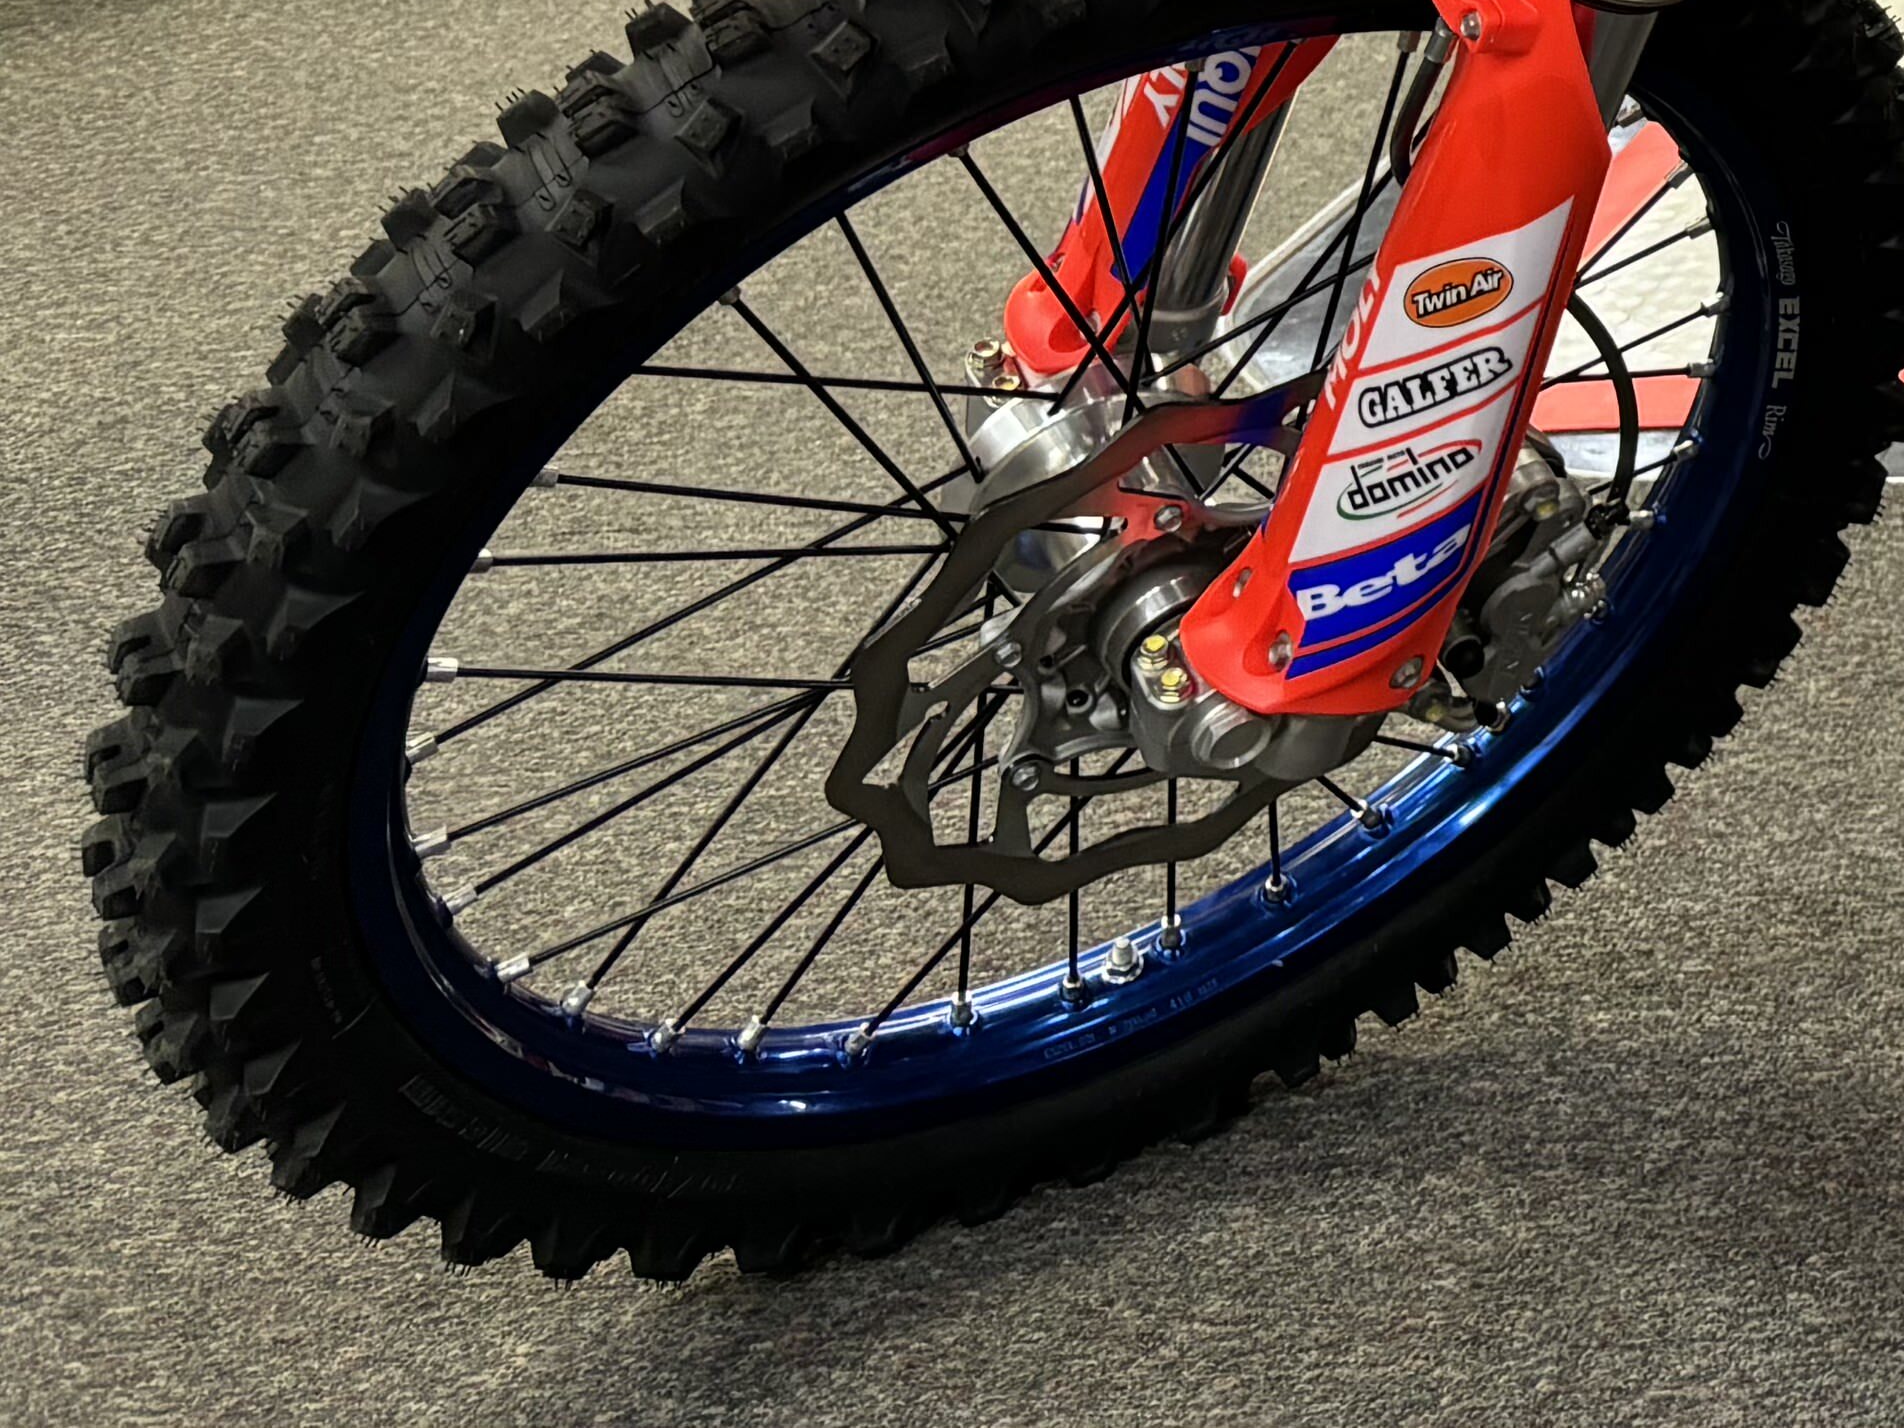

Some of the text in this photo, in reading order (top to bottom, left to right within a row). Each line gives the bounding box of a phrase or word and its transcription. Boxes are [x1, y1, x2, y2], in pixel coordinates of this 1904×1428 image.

[1413, 268, 1504, 320] Twin Air
[1771, 295, 1800, 389] EXCEL
[1357, 347, 1514, 428] GALFER
[1346, 444, 1476, 511] domino
[1297, 523, 1472, 621] Beta
